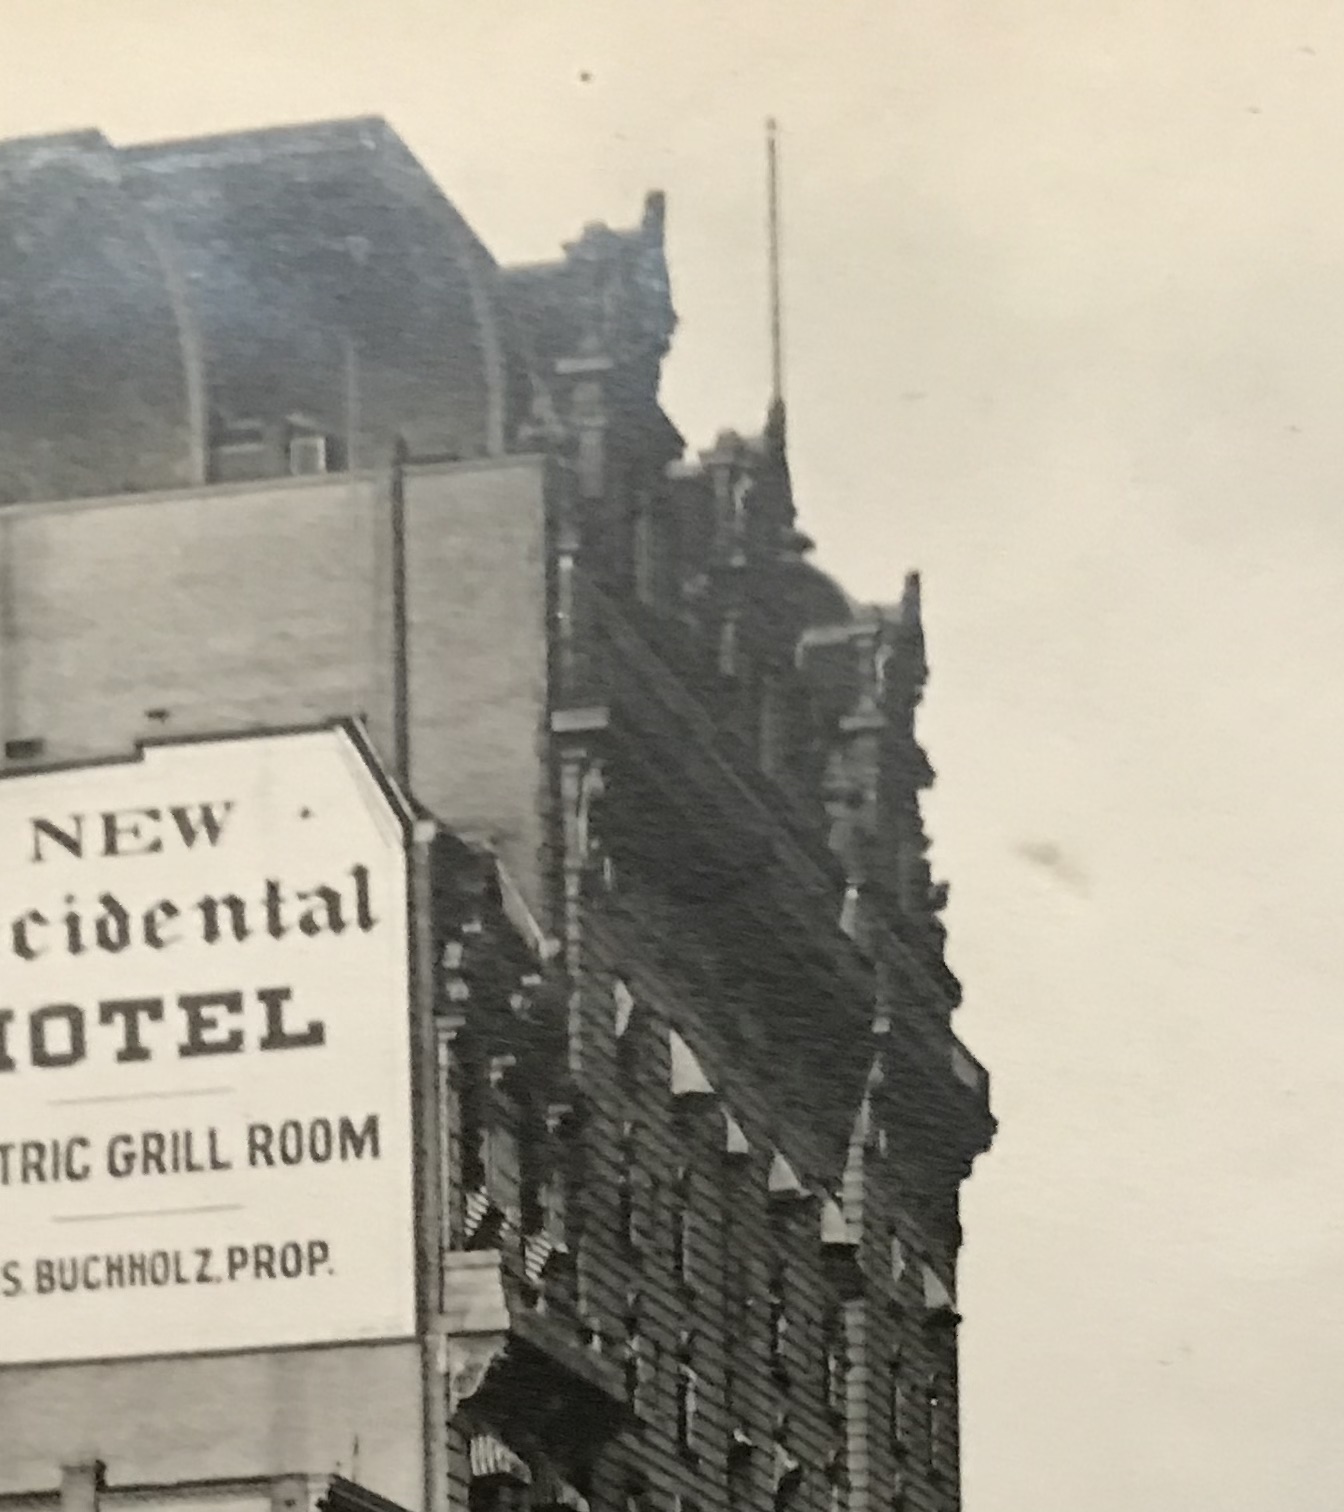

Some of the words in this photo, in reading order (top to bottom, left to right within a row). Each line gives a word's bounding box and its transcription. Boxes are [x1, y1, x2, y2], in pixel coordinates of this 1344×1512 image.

[30, 800, 233, 864] NEW
[106, 1127, 233, 1179] GRILL
[247, 1113, 382, 1168] ROOM
[226, 1239, 336, 1282] PROP.
